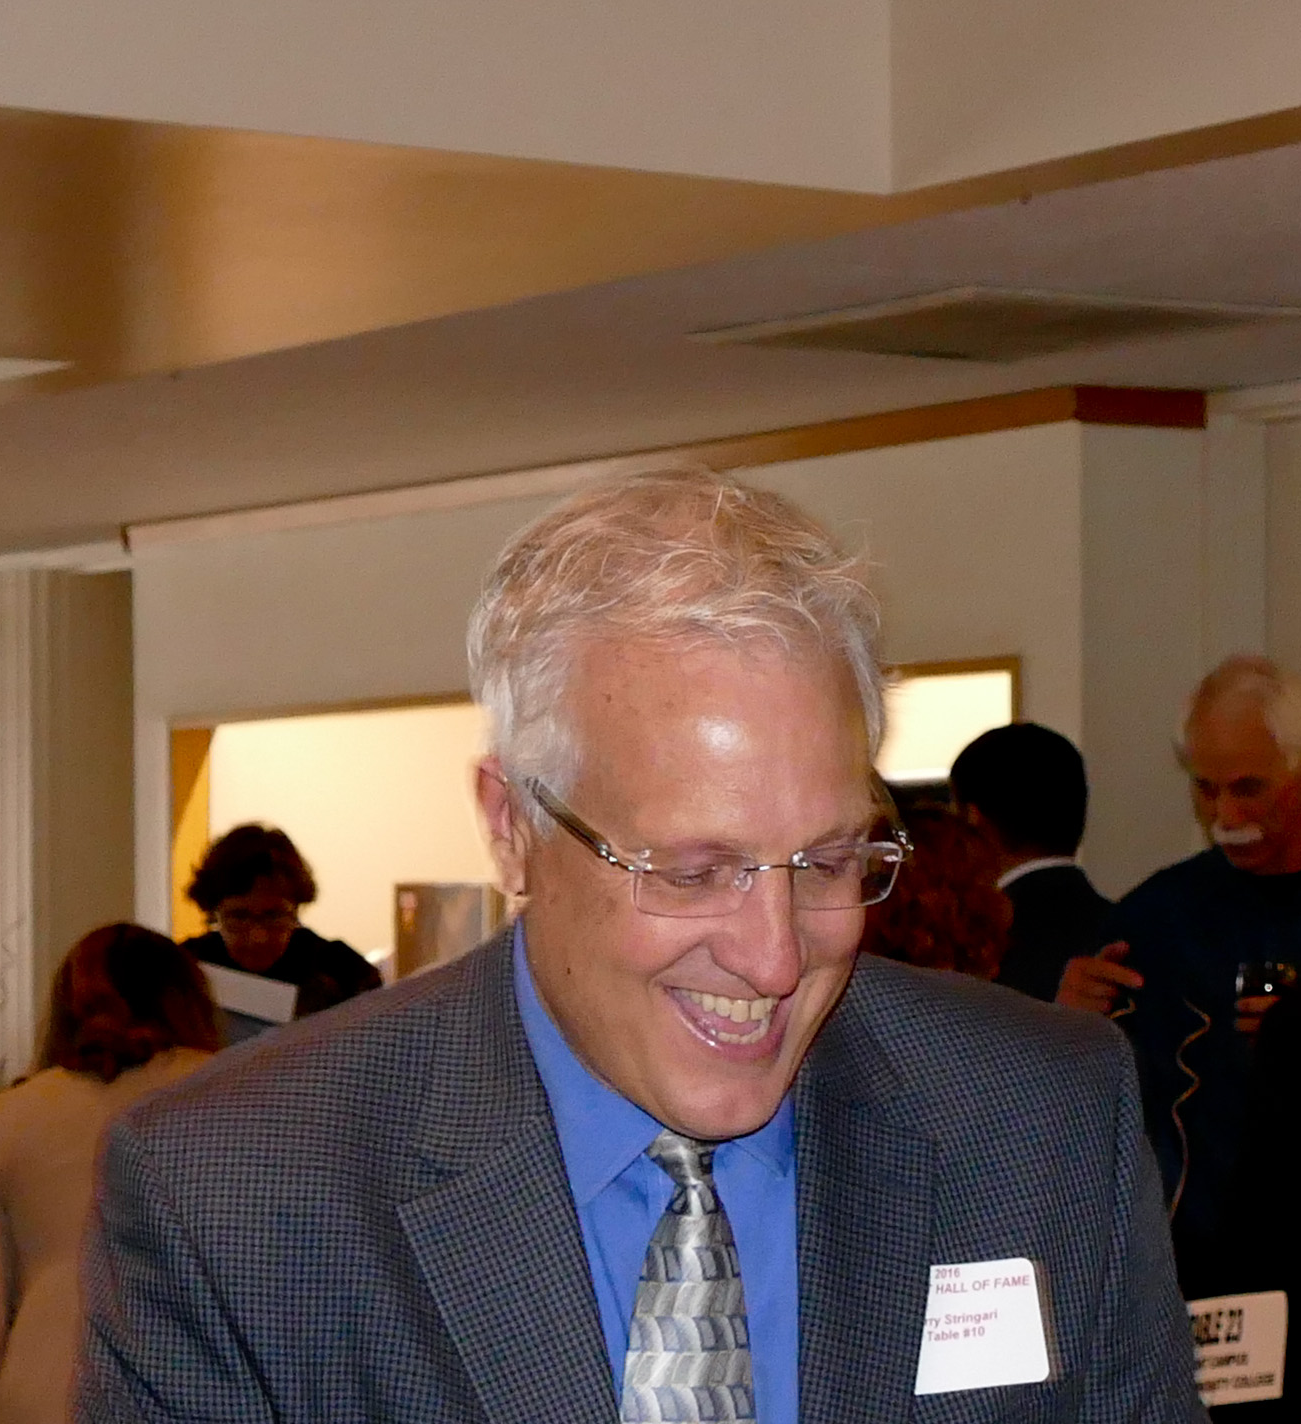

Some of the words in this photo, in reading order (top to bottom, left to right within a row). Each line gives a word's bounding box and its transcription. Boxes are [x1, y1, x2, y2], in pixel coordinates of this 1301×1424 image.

[934, 1267, 961, 1280] 2016
[936, 1283, 968, 1295] HALL
[972, 1279, 990, 1292] OF
[994, 1275, 1031, 1288] FAME
[945, 1309, 997, 1325] Stringari
[927, 1329, 960, 1342] Table
[963, 1325, 986, 1339] #10
